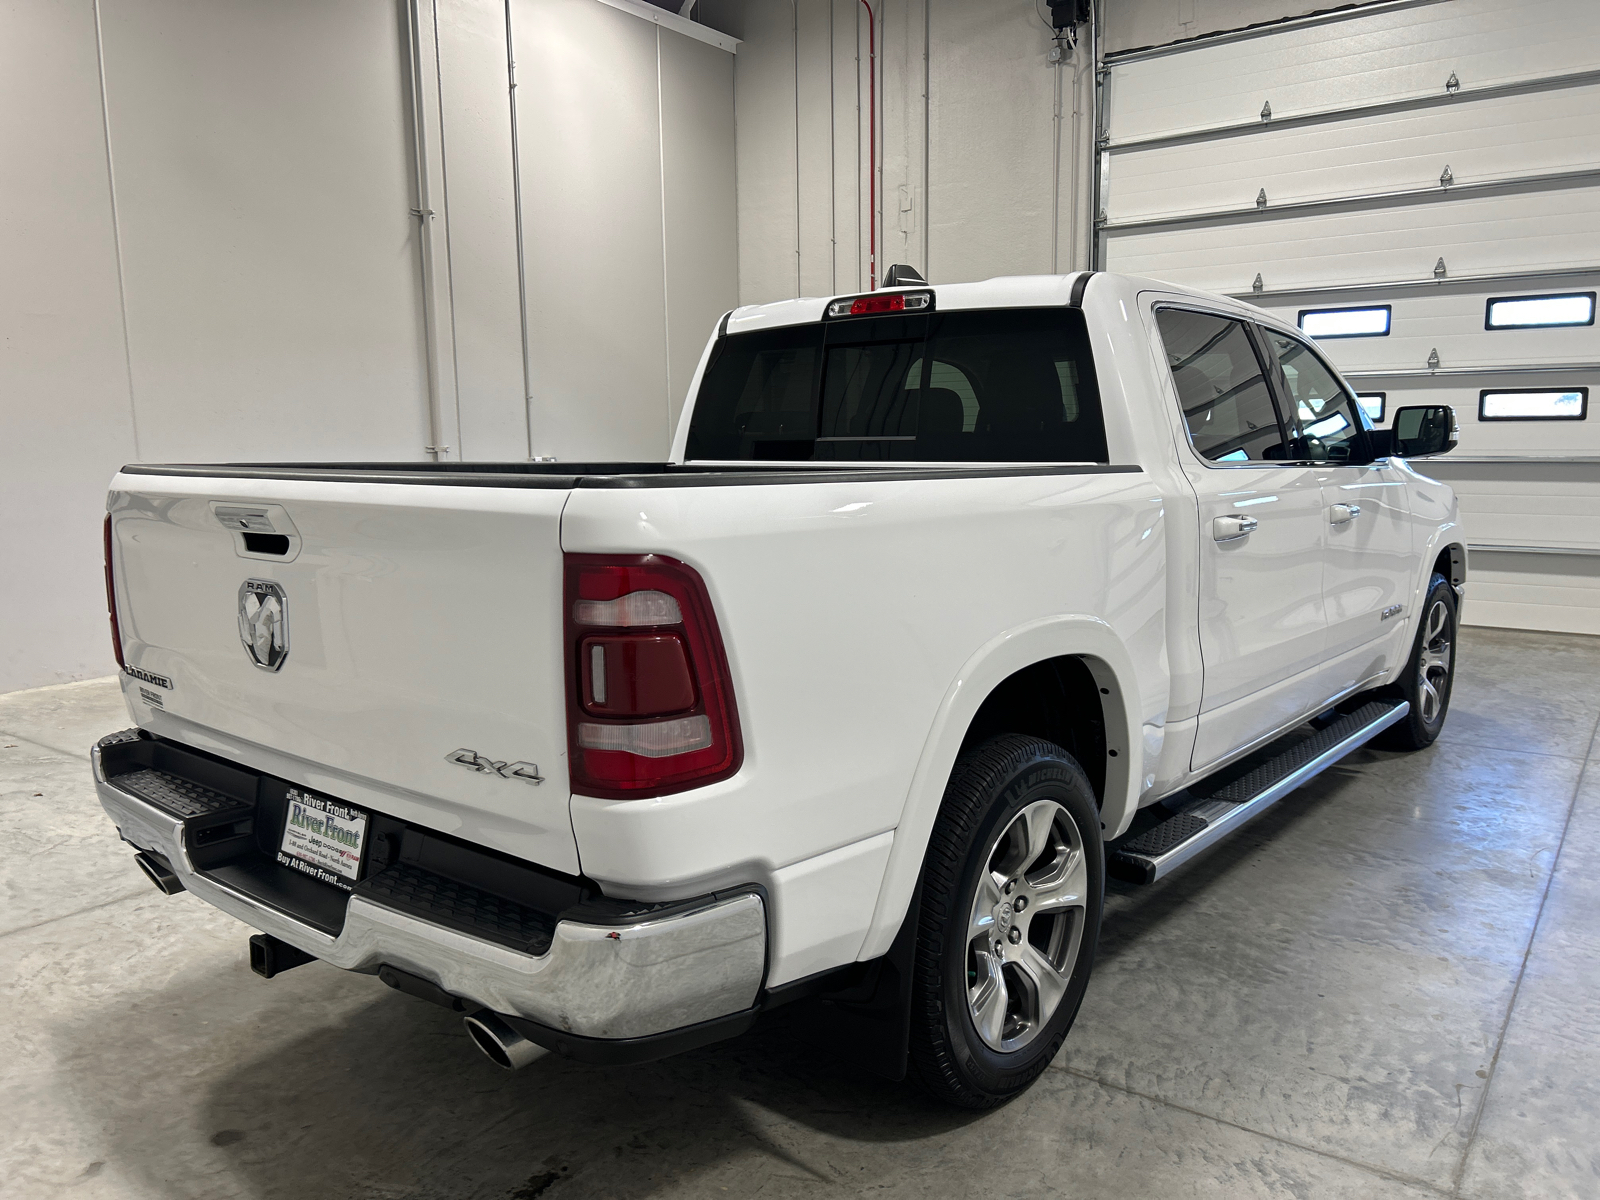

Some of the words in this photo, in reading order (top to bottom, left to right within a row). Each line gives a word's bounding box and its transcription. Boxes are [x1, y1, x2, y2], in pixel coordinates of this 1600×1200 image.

[247, 582, 274, 592] RAM
[125, 665, 169, 689] LARAMIE
[1028, 768, 1073, 787] MICHELIN
[303, 793, 325, 811] River
[309, 835, 323, 848] Jeep
[277, 851, 291, 867] Buy
[290, 857, 300, 869] At
[299, 860, 318, 876] River
